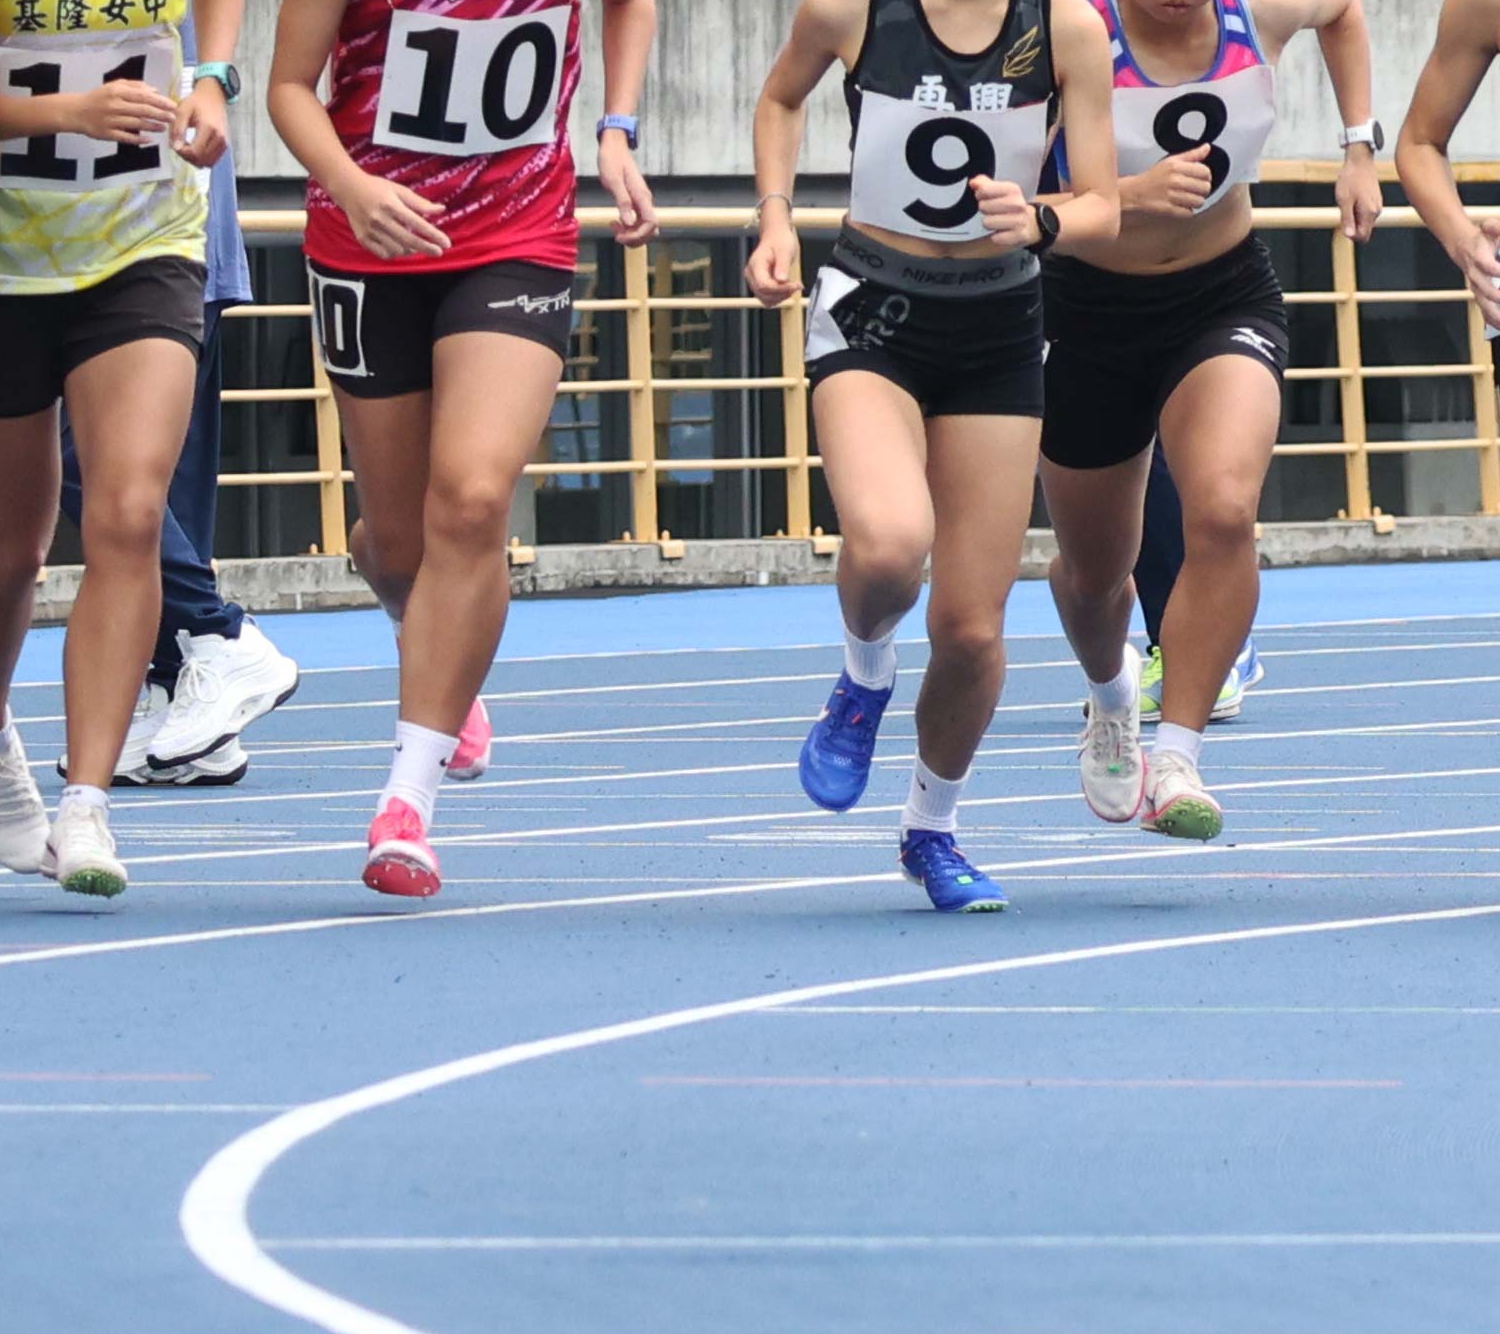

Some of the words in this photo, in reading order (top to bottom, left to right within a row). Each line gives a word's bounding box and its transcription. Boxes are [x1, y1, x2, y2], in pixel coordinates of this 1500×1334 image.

[0, 54, 161, 182] 11
[388, 21, 557, 144] 10
[902, 116, 996, 229] 9
[1153, 91, 1230, 200] 8
